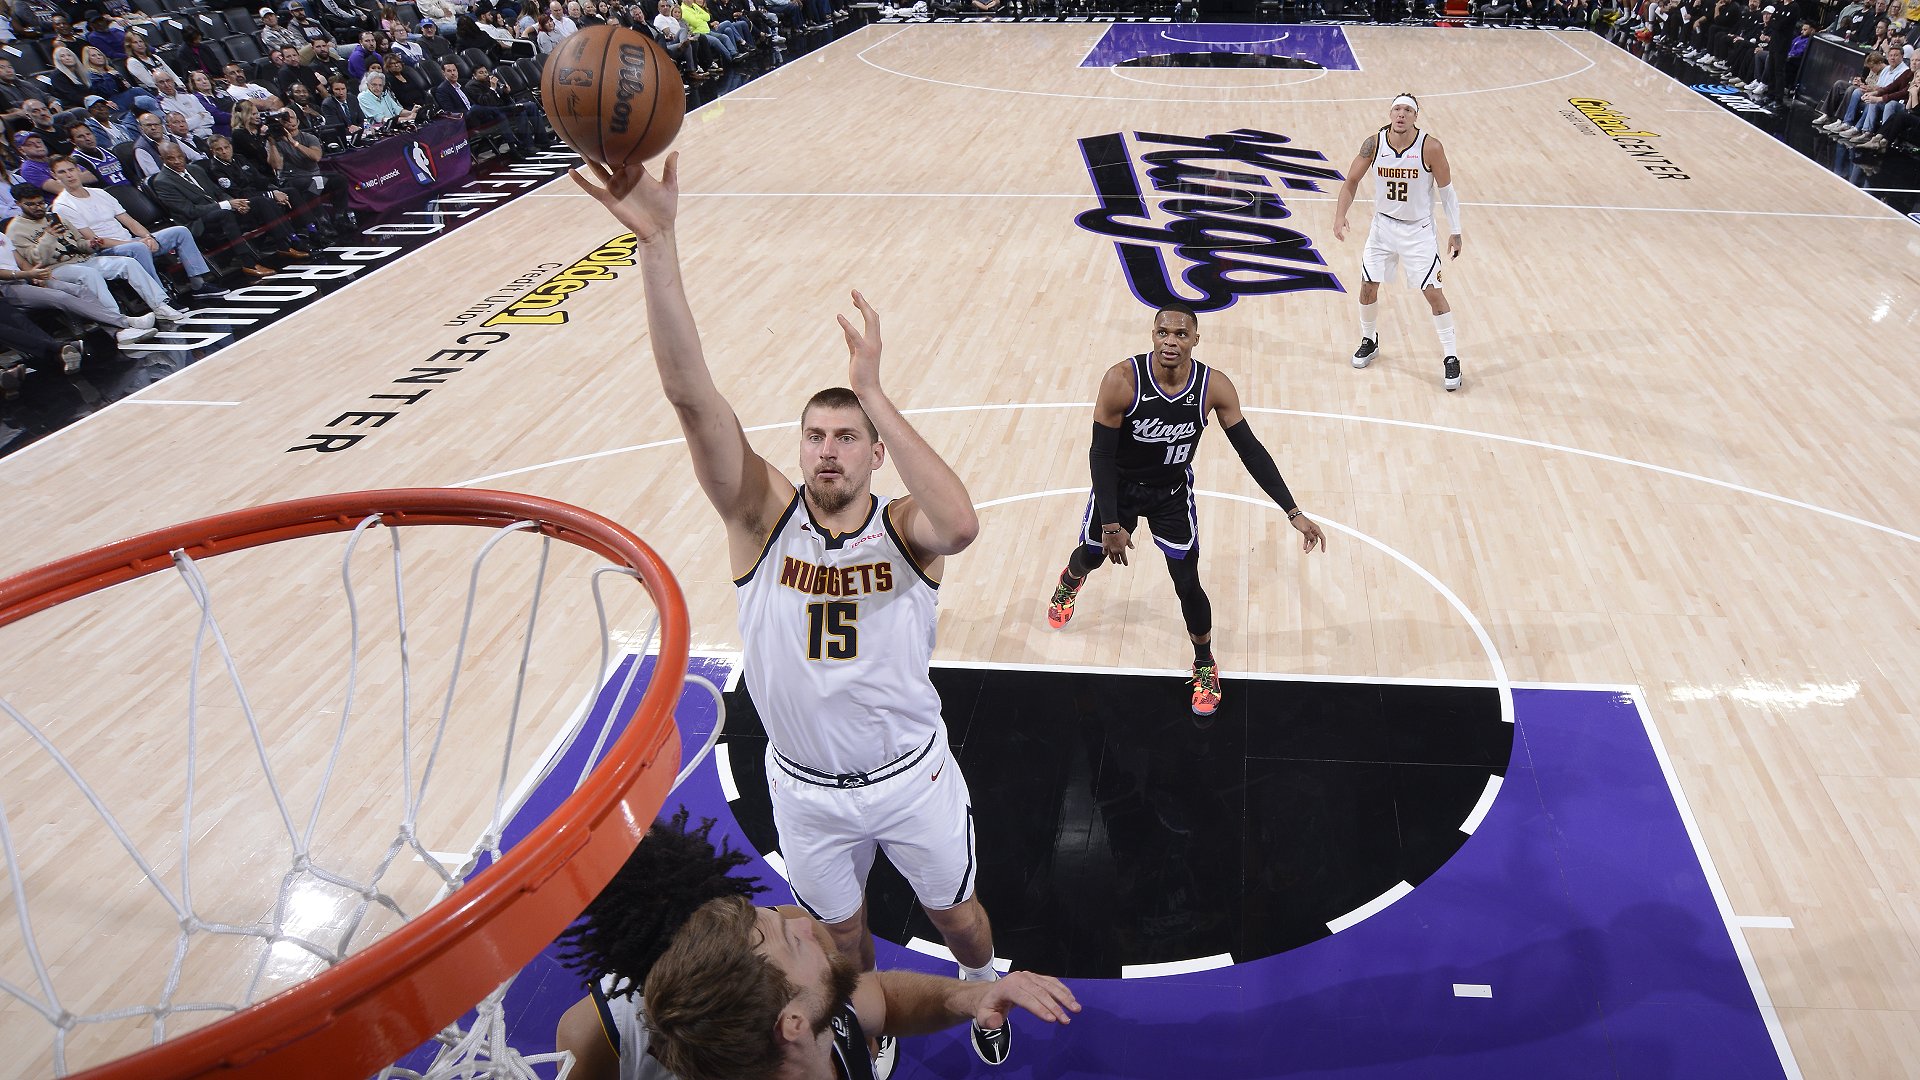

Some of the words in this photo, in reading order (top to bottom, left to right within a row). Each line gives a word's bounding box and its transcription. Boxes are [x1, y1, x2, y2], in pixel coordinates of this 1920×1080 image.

[609, 43, 646, 134] Wilson
[1377, 166, 1419, 179] NUGGETS
[1612, 137, 1691, 180] CENTER
[366, 178, 379, 188] NBC
[380, 169, 400, 185] peacock
[1386, 181, 1408, 202] 32
[1074, 128, 1348, 313] Kings
[500, 262, 563, 292] Credit
[118, 246, 403, 351] PROUD
[443, 295, 514, 327] Union
[286, 331, 510, 453] CENTER
[1132, 417, 1197, 443] Kings
[1164, 443, 1192, 465] 18
[780, 555, 893, 597] NUGGETS
[806, 602, 858, 661] 15
